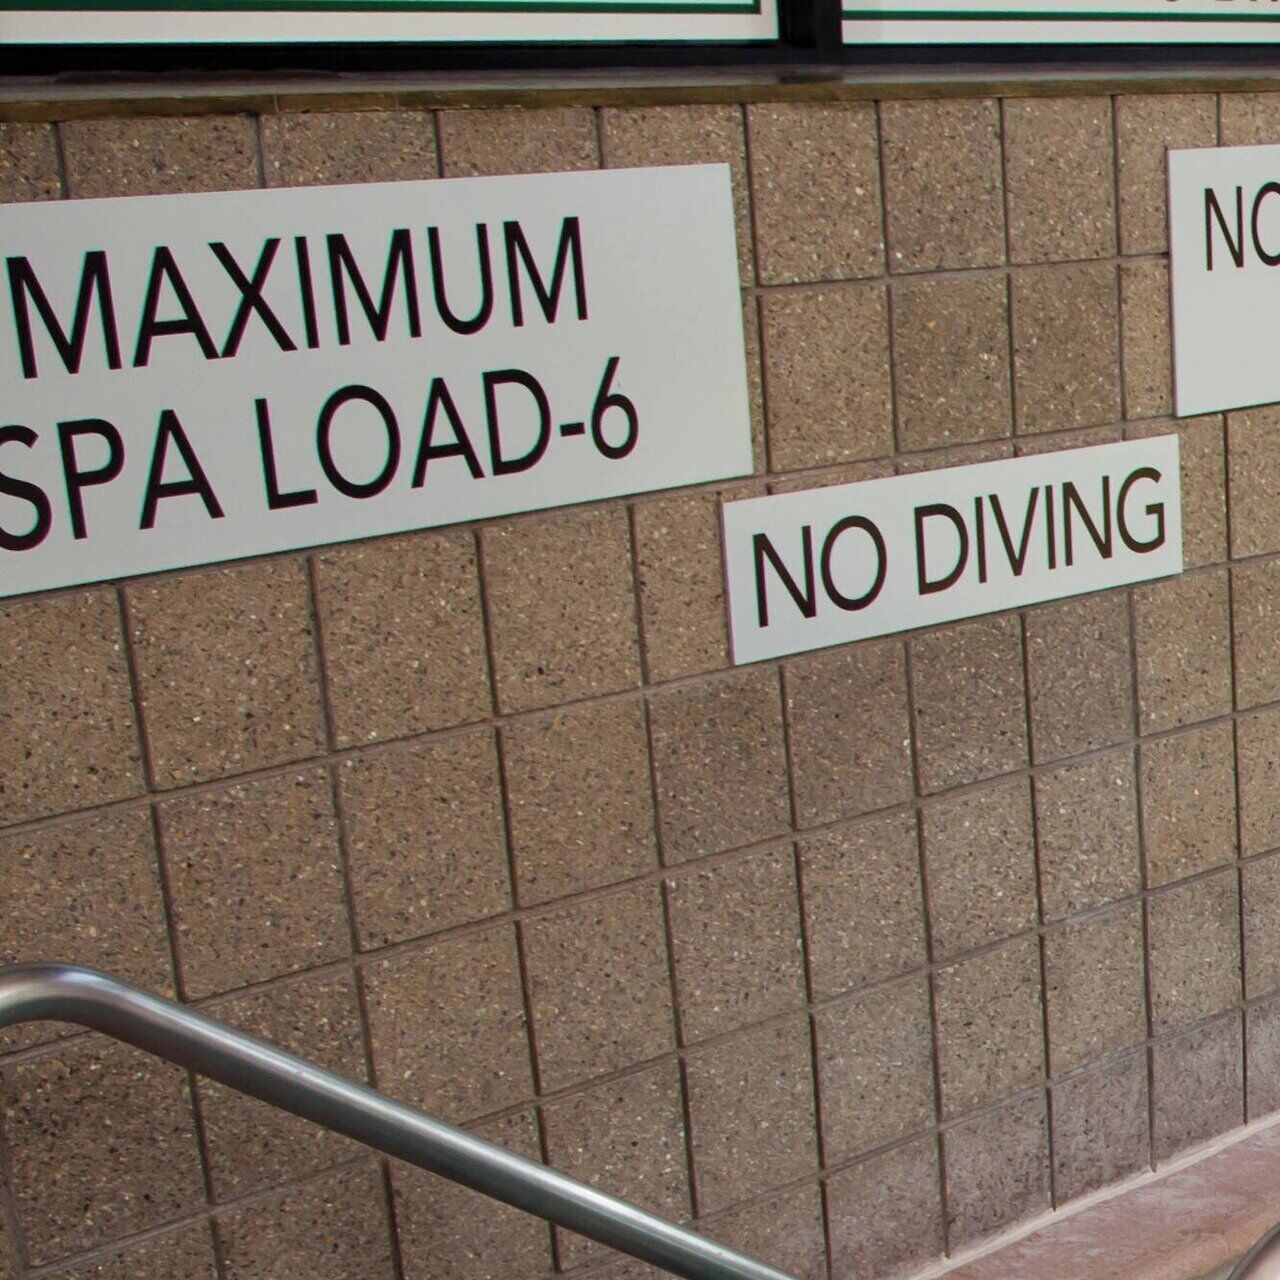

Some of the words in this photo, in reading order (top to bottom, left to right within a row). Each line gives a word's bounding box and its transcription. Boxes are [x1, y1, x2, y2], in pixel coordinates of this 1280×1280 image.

[5, 216, 588, 380] MAXIMUM
[0, 409, 225, 552] SPA
[254, 356, 639, 510] LOAD-6
[752, 515, 888, 628] NO
[914, 467, 1166, 596] DIVING
